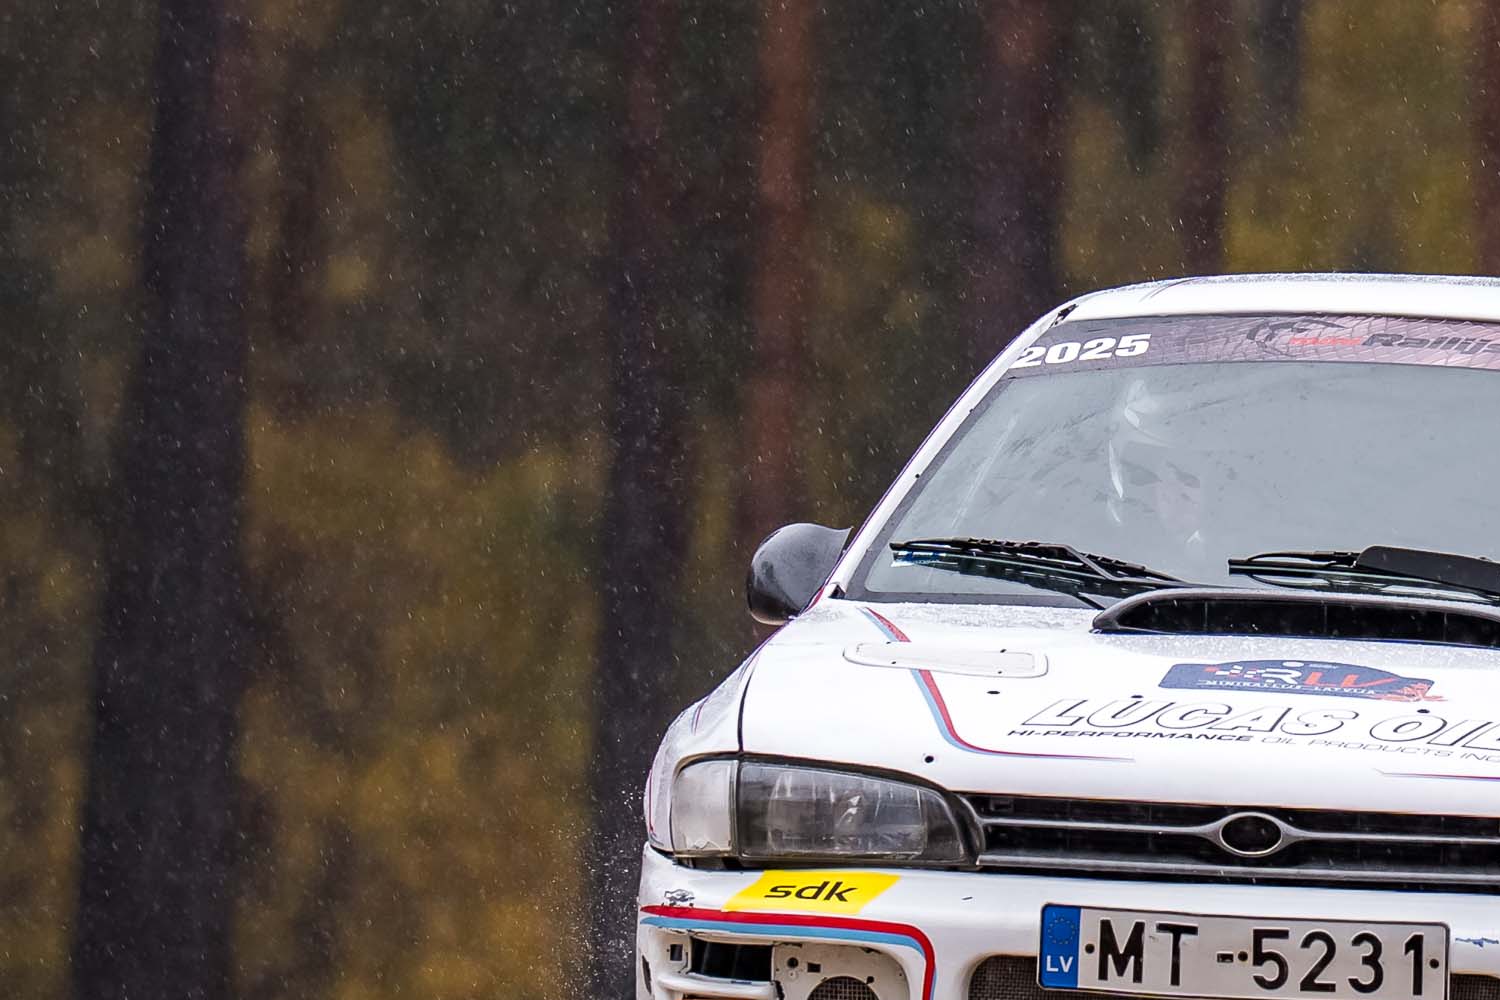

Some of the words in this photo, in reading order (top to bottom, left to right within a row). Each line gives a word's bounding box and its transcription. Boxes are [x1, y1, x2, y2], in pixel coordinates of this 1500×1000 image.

[1008, 333, 1152, 368] 2025
[1021, 699, 1359, 735] LUCAS
[1007, 730, 1254, 742] HI-PERFORMANCE
[1261, 737, 1297, 745] OIL
[1308, 739, 1454, 757] PRODUCTS
[764, 881, 859, 902] sdk
[1046, 955, 1074, 973] LV
